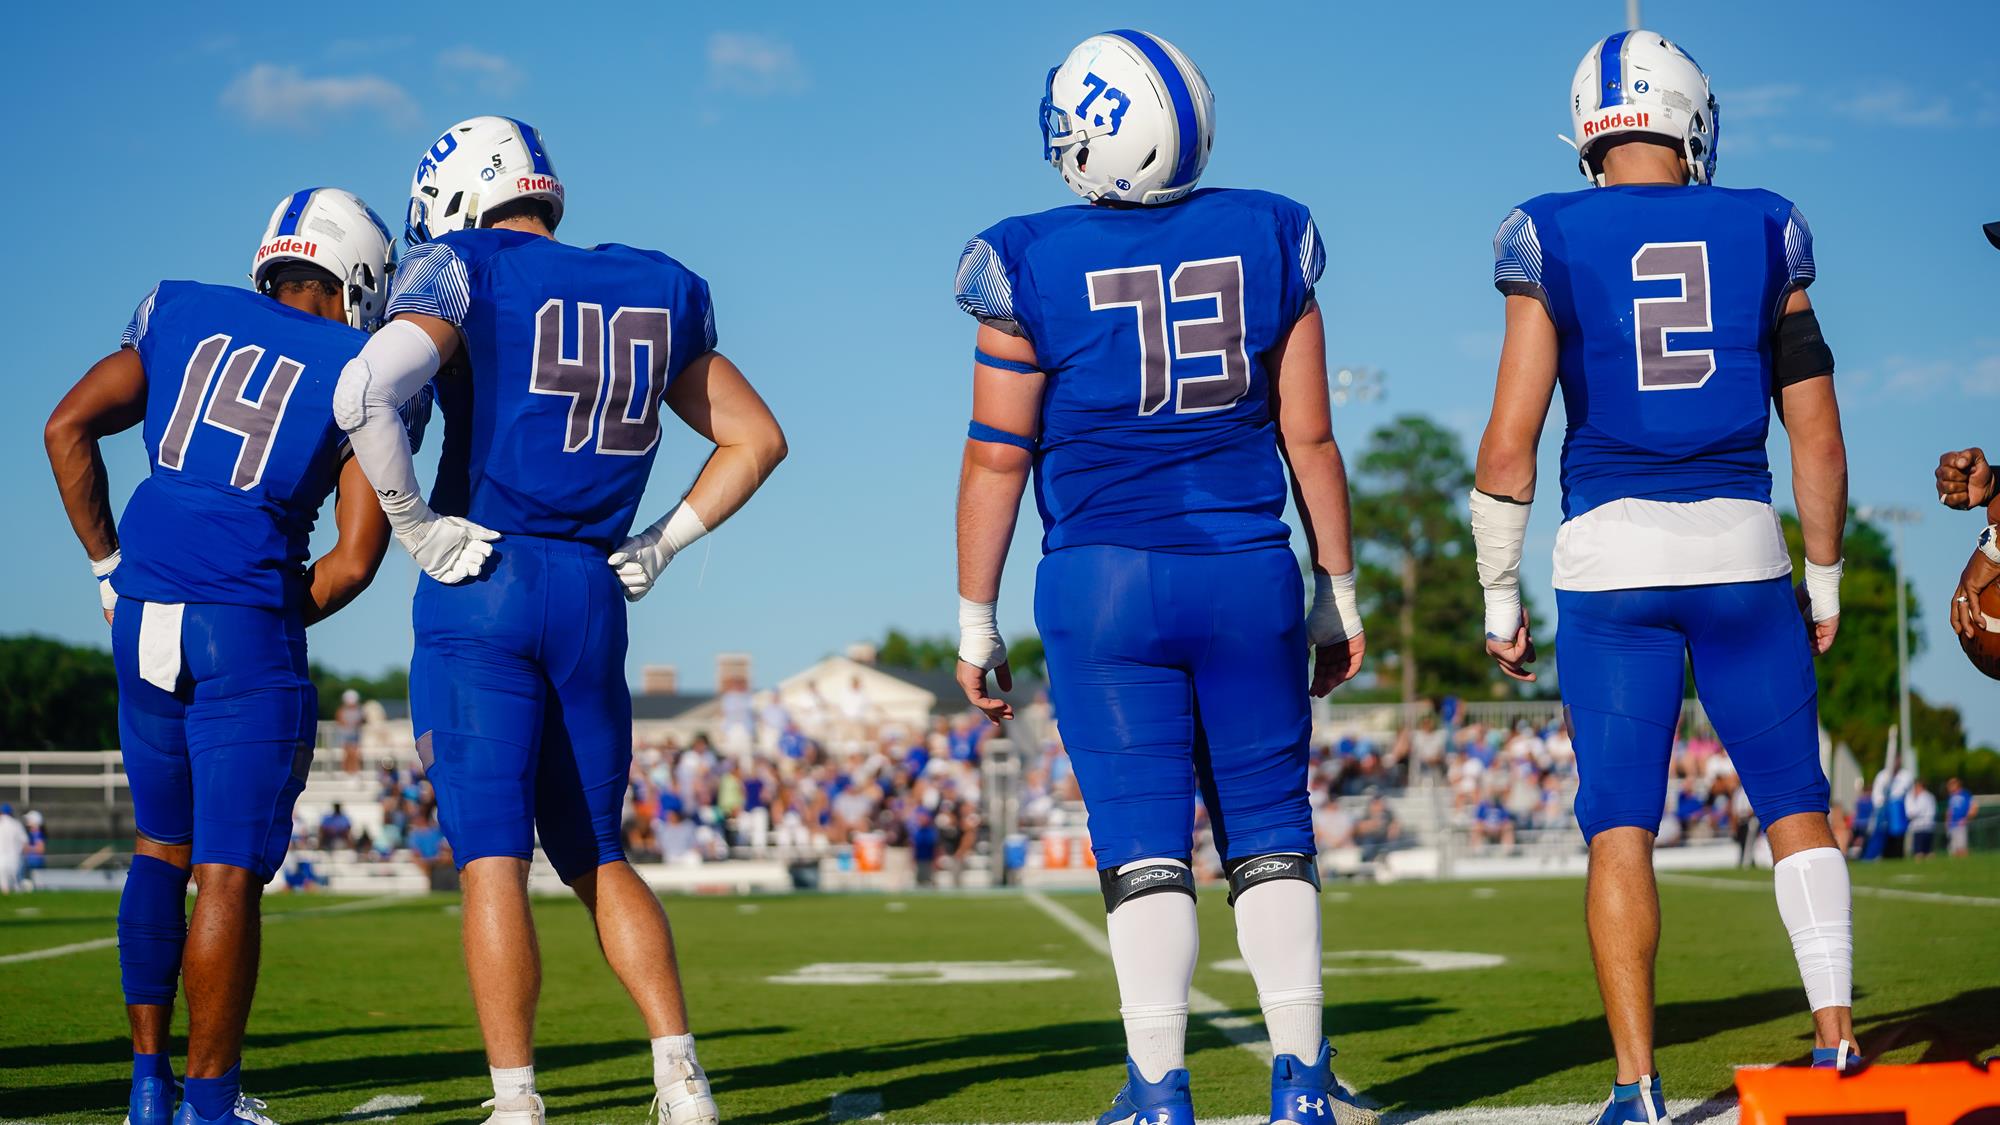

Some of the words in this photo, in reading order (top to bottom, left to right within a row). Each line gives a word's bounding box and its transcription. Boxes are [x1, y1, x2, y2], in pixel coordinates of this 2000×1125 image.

[1076, 72, 1131, 136] 73
[1636, 80, 1647, 93] 2
[1583, 112, 1650, 138] Riddell
[1117, 180, 1129, 190] 73
[257, 238, 318, 263] Riddell
[1085, 255, 1251, 416] 73
[1631, 241, 1716, 391] 2
[530, 299, 671, 456] 40
[158, 333, 305, 491] 14
